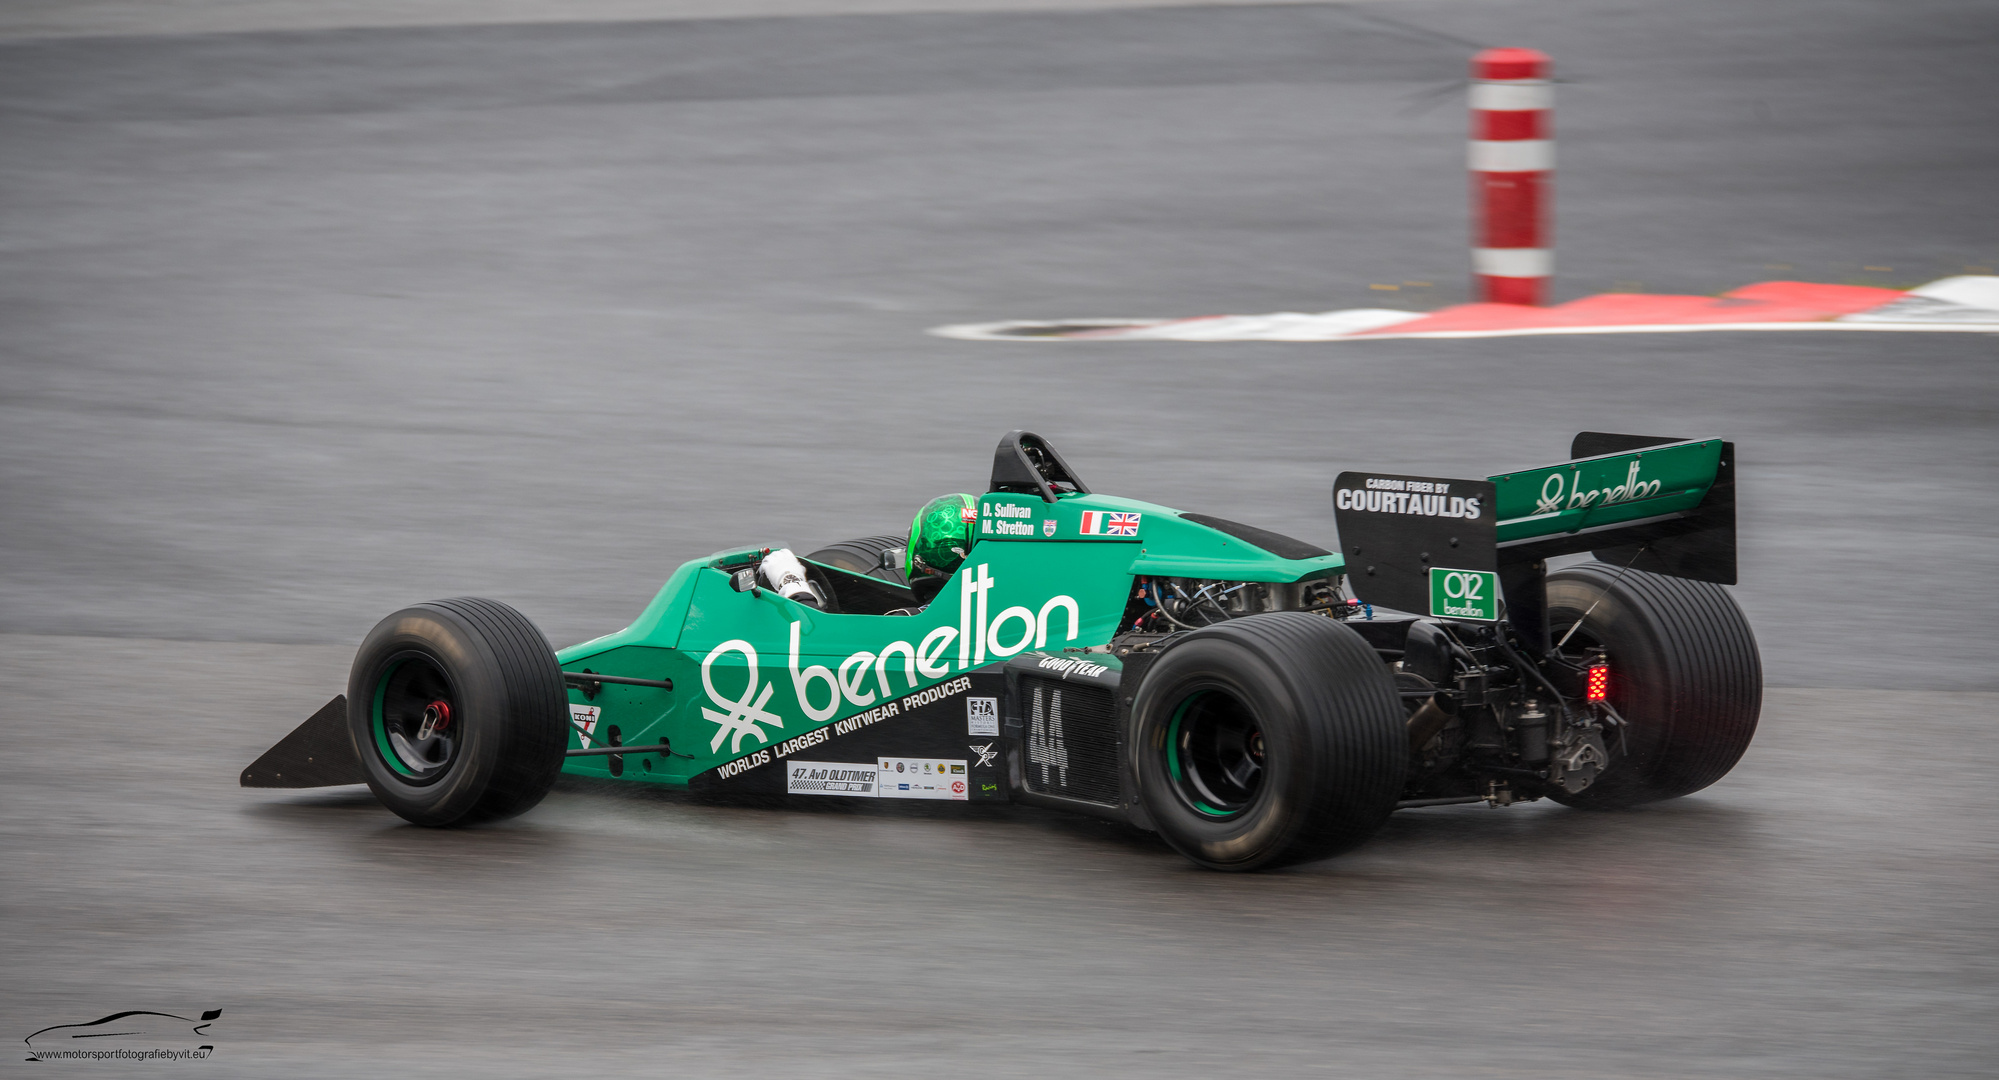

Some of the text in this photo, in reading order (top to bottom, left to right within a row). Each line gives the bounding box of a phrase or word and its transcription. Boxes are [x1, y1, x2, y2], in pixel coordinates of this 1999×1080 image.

[1366, 478, 1450, 494] CARBON FIBER BY
[1565, 460, 1662, 510] benetton
[983, 503, 1031, 518] D. Sullivan
[1336, 488, 1481, 520] COURTAULDS
[982, 520, 1034, 536] M. Stretton
[1444, 572, 1483, 600] 012
[1444, 598, 1484, 617] benetton
[789, 563, 1079, 722] benetton
[574, 713, 595, 722] KONI
[717, 676, 972, 780] WORLDS LARGEST KNITWEAR PRODUCER
[1030, 687, 1068, 786] 44
[792, 768, 876, 782] 47. AvD OLDTIMER
[825, 781, 863, 792] GRAND PRIX
